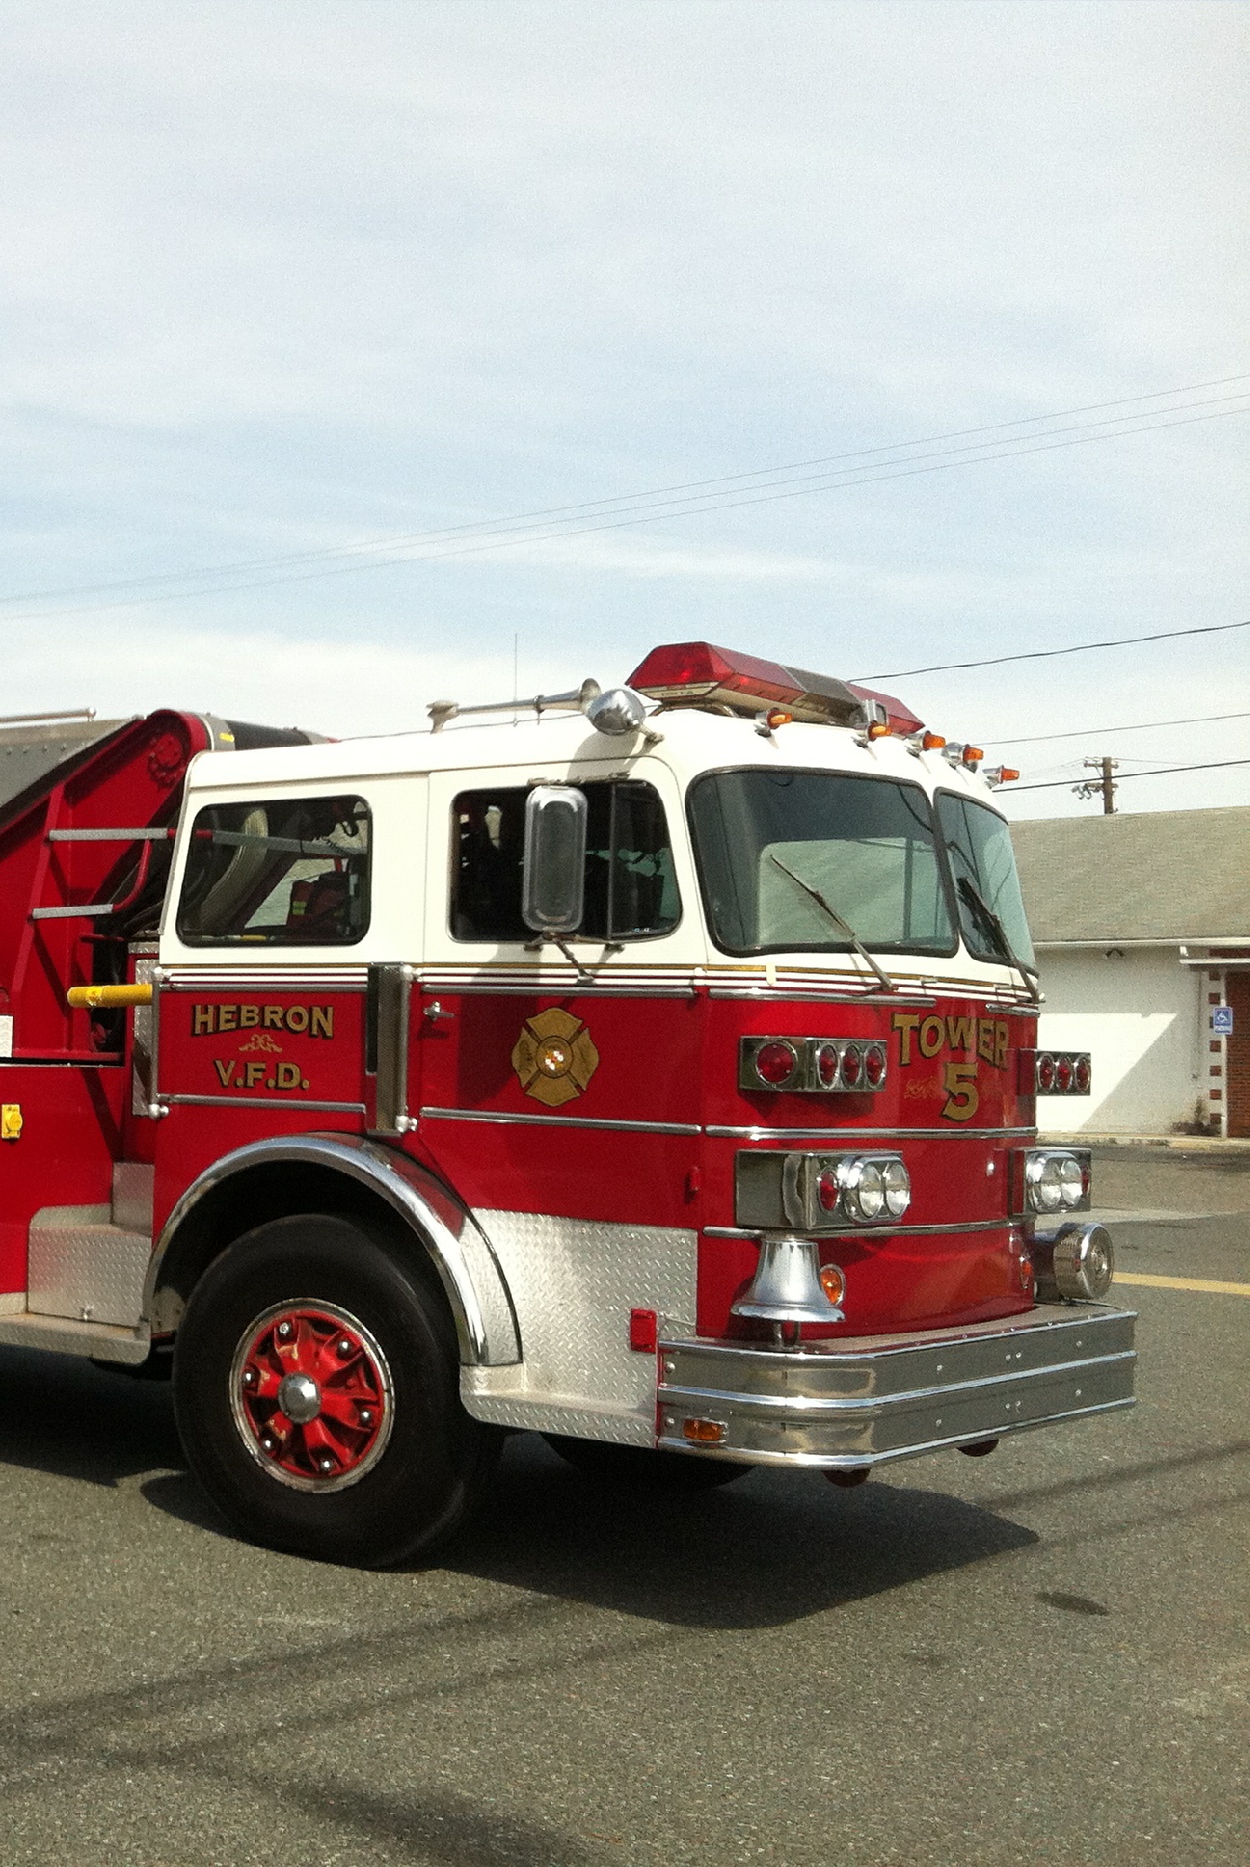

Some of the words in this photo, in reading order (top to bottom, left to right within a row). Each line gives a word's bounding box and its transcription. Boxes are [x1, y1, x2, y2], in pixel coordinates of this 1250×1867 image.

[191, 1004, 334, 1039] HEBRON
[892, 1012, 1009, 1072] TOWER
[213, 1059, 310, 1090] V.F.D.
[940, 1062, 979, 1122] 5
